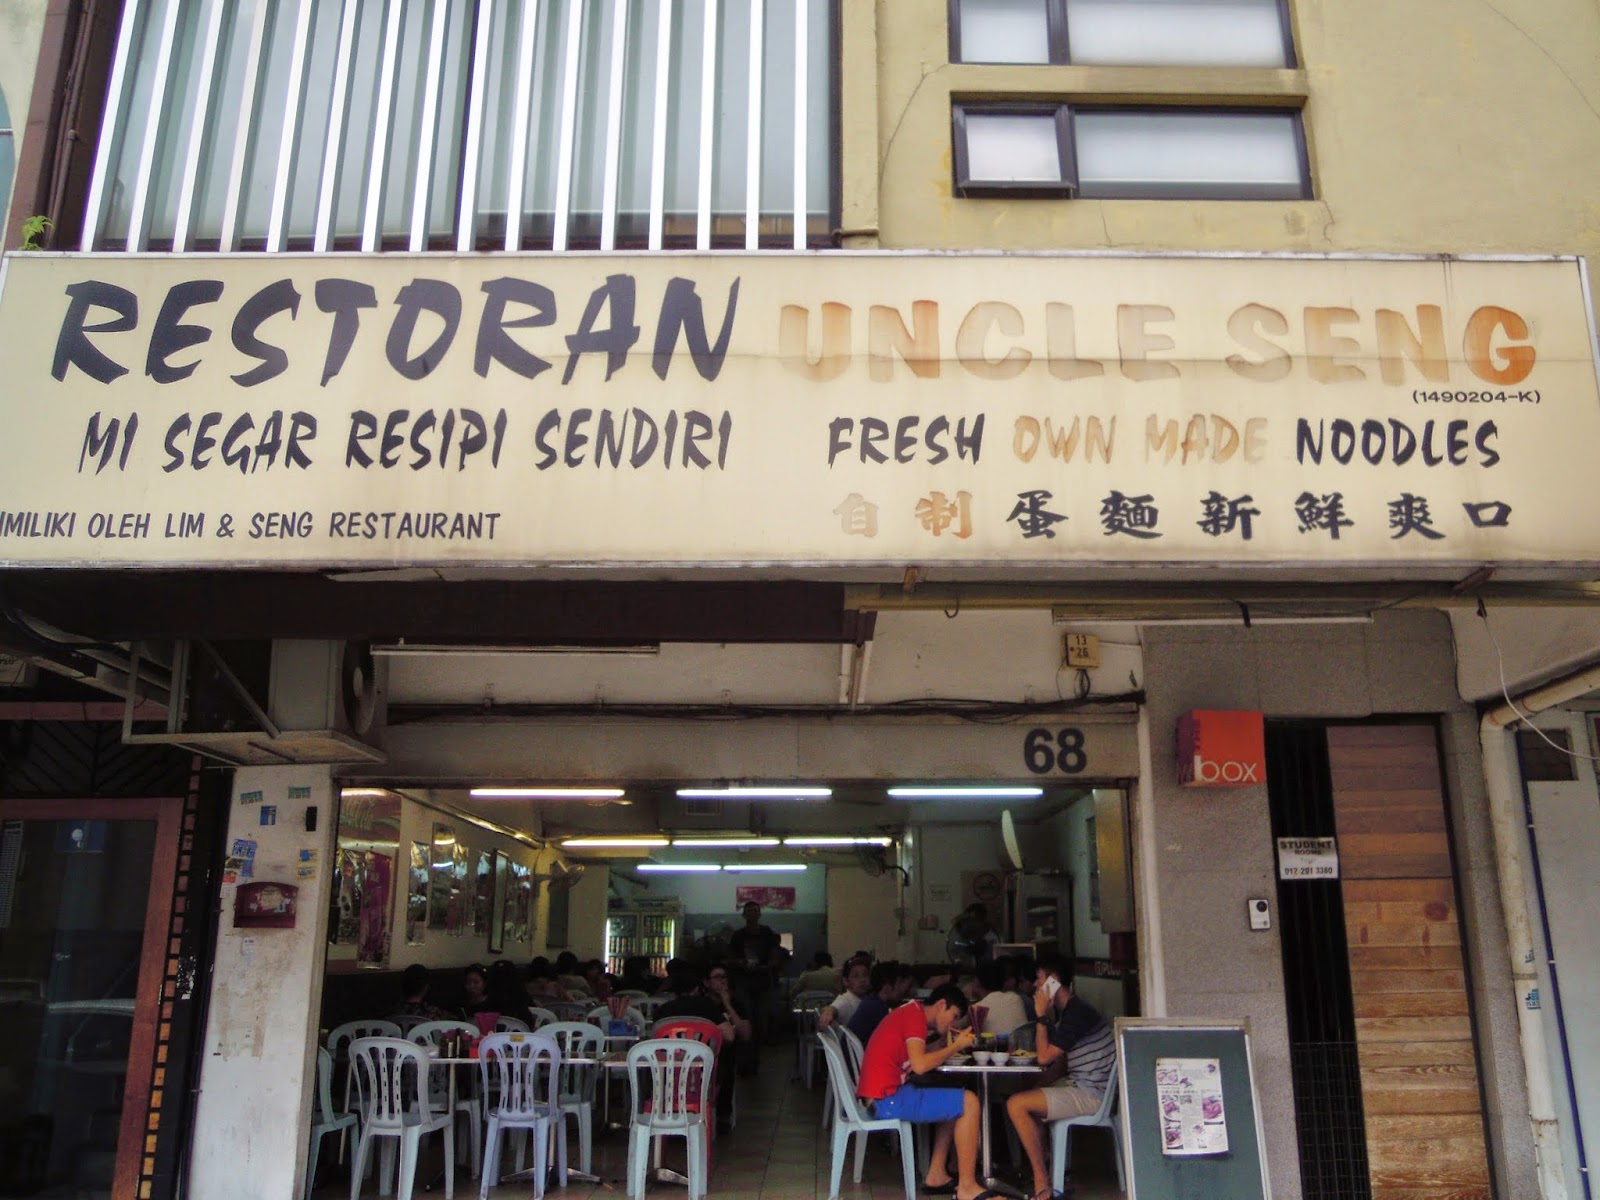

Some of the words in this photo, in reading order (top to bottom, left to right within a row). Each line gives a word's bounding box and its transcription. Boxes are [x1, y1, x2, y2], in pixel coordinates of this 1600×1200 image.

[51, 273, 742, 387] RESTORAN
[778, 299, 1181, 382] UNCLE
[1225, 302, 1536, 386] SENG
[1412, 390, 1541, 405] (1490204-K)
[78, 411, 139, 475] MI
[162, 410, 319, 475] SEGAR
[346, 408, 508, 473] RESIPI
[535, 408, 733, 472] SENDIRI
[827, 413, 986, 469] FRESH
[1012, 413, 1118, 465] OWN
[1145, 413, 1269, 466] MADE
[1296, 417, 1501, 469] NOODLES
[87, 513, 151, 539] OLEH
[164, 513, 206, 539] LIM
[216, 513, 235, 538] &
[248, 512, 314, 540] SENG
[329, 511, 502, 541] RESTAURANT
[1075, 635, 1087, 645] 13
[1076, 647, 1089, 657] 26
[1024, 728, 1087, 774] 68
[1194, 754, 1257, 782] box
[1280, 840, 1333, 850] STUDENT
